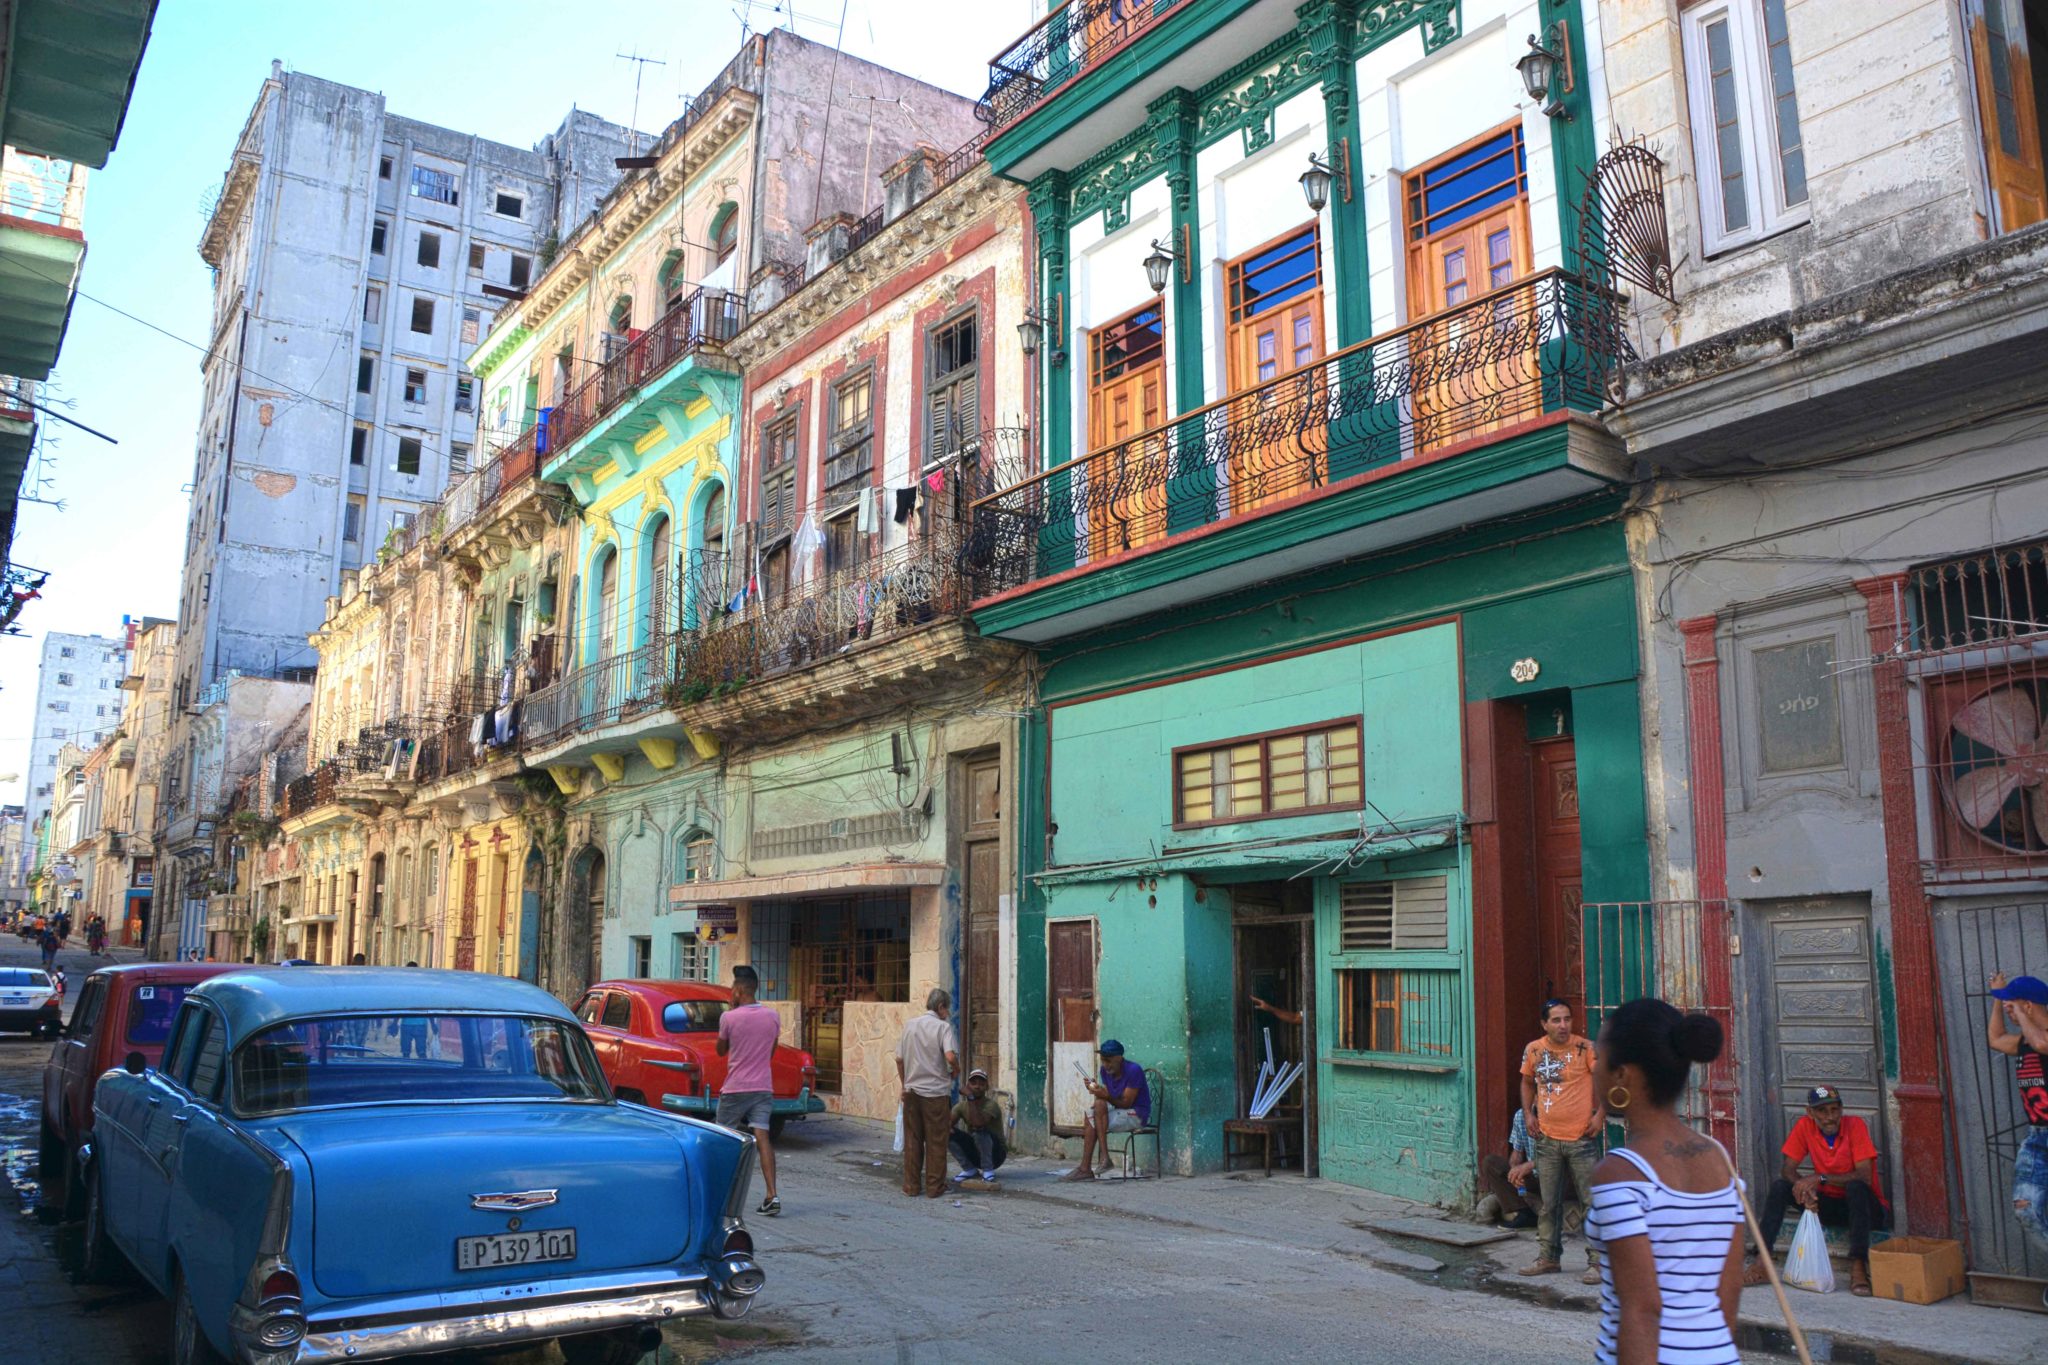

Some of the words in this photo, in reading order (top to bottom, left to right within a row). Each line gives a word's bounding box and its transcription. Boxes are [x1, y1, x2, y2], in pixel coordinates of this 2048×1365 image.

[1515, 663, 1534, 678] 204
[475, 1238, 530, 1266] P139
[535, 1233, 575, 1260] 101
